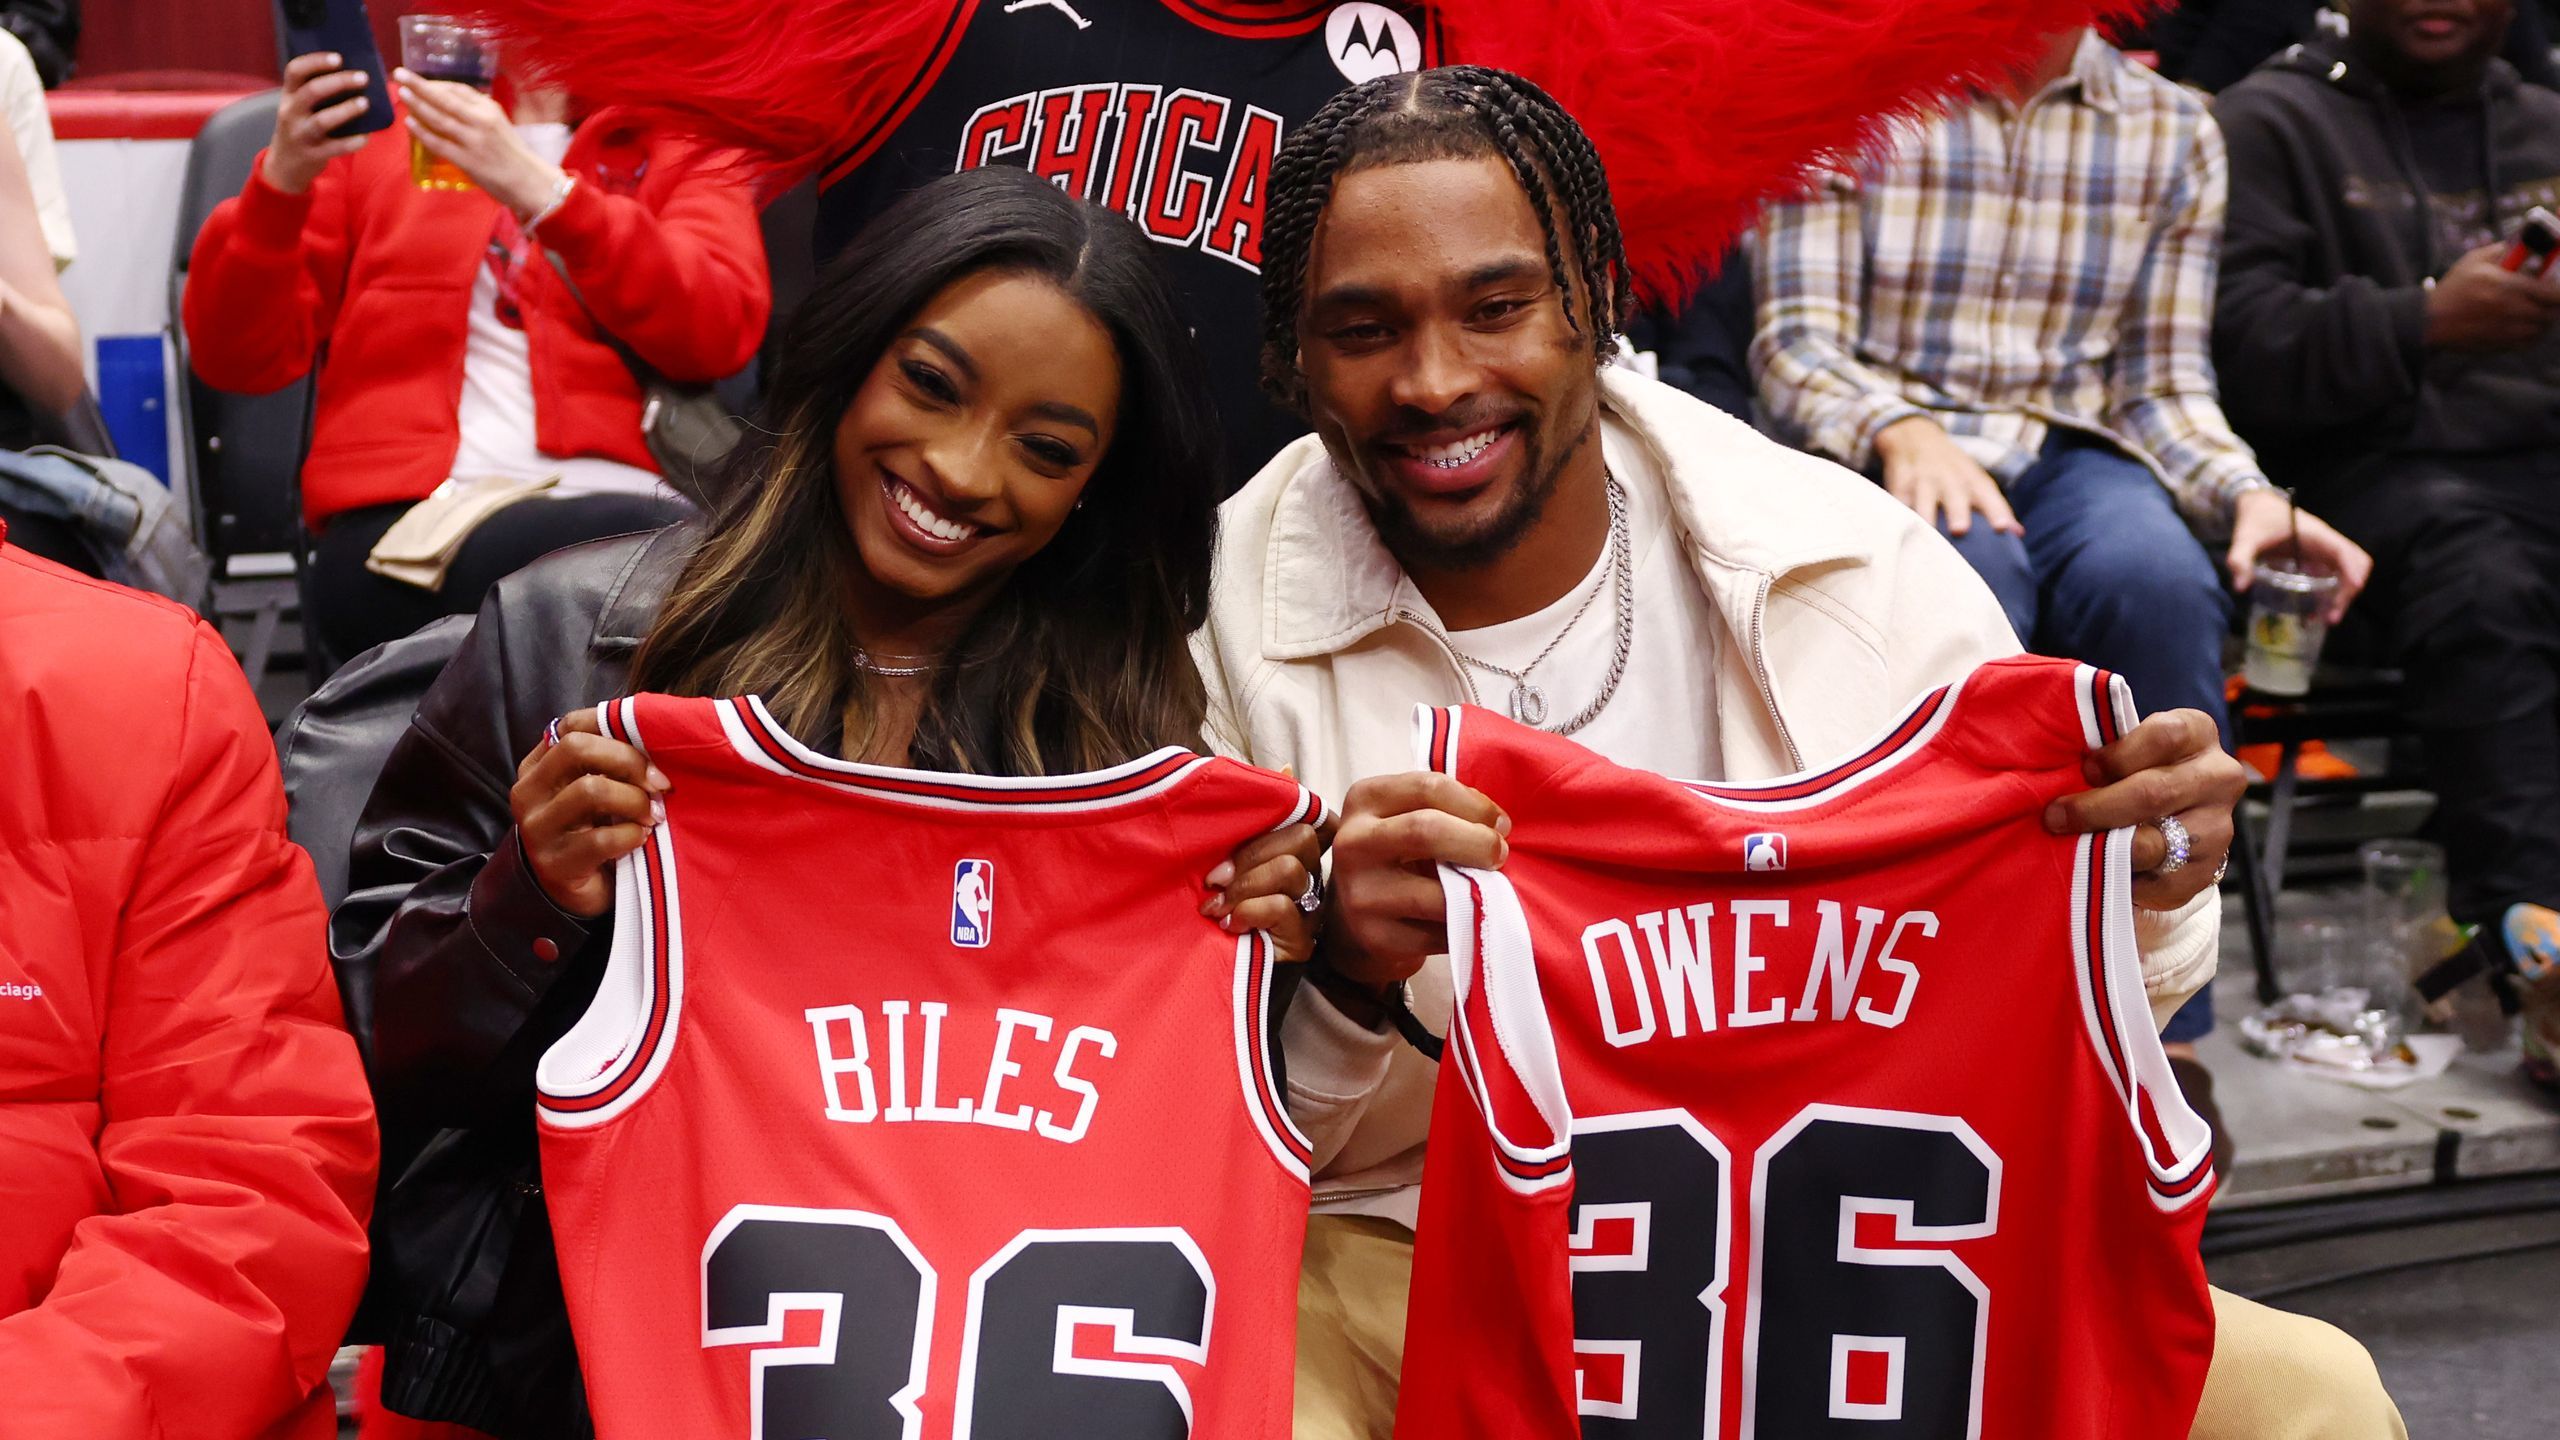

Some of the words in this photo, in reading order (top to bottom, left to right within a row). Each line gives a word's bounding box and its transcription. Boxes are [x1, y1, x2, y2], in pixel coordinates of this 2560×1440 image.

[956, 926, 976, 942] NBA
[1580, 899, 1940, 1049] OWENS
[804, 1000, 1118, 1144] BILES
[701, 1203, 1217, 1440] 36
[1569, 1102, 2003, 1440] 36
